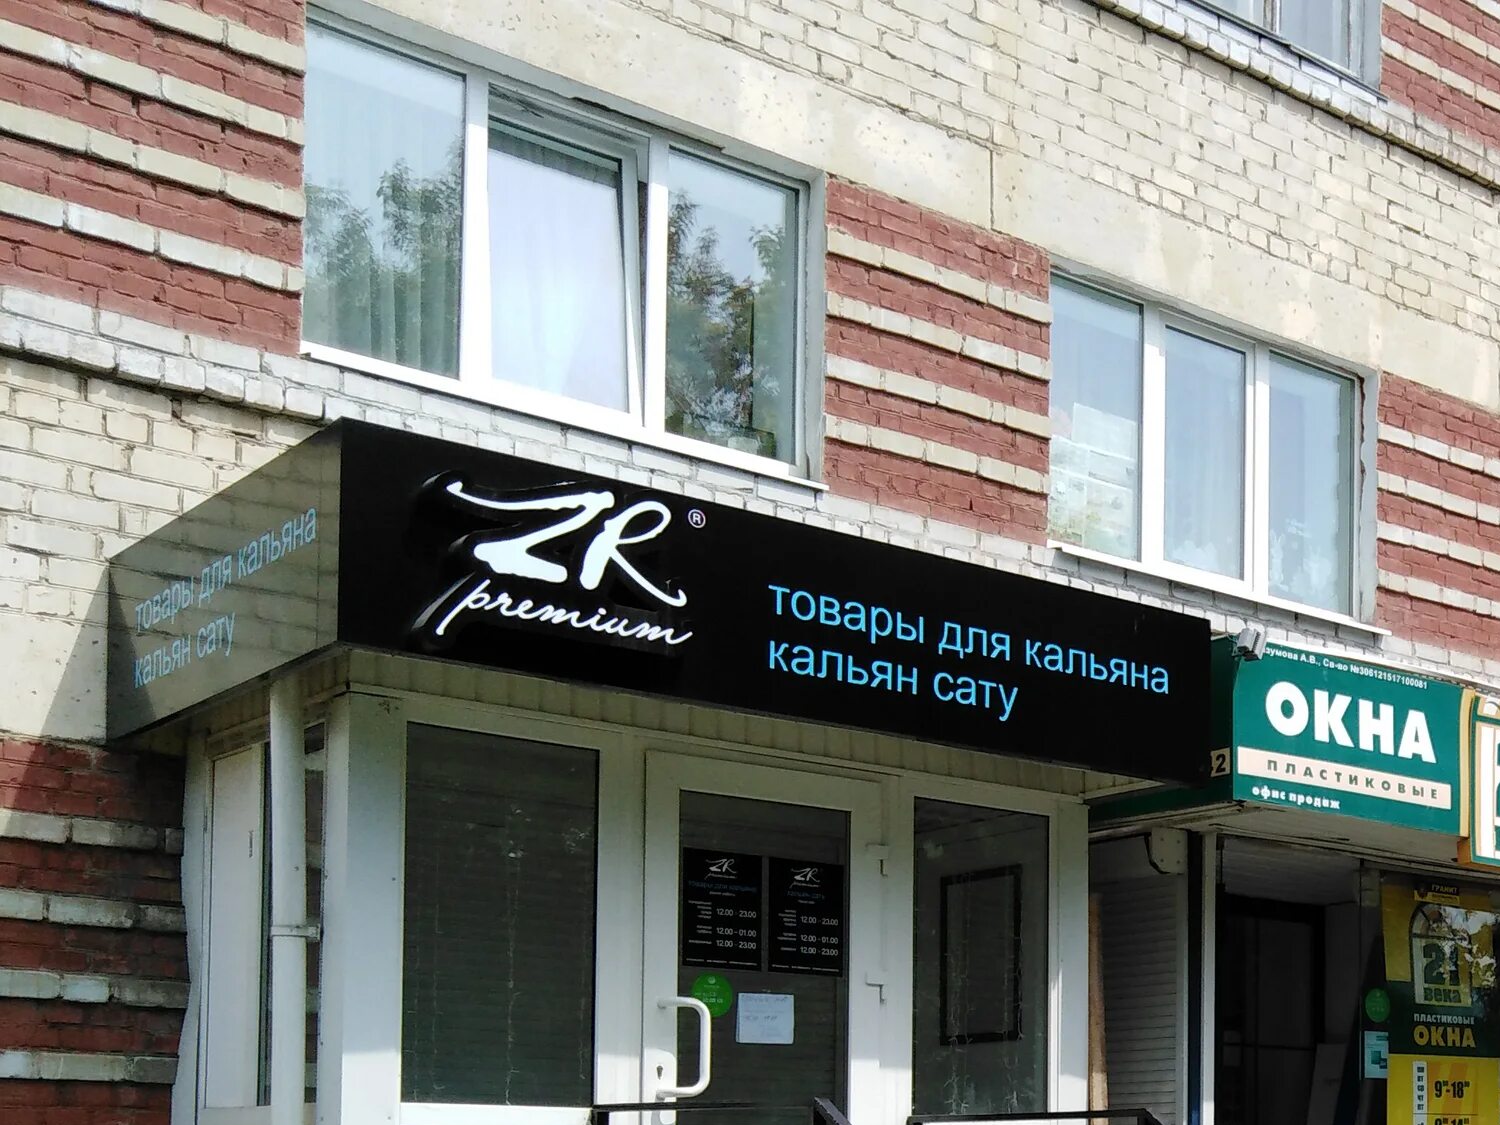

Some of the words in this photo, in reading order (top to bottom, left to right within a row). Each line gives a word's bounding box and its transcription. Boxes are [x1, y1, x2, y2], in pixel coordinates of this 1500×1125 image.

[135, 576, 194, 633] товары
[198, 554, 233, 607] для
[237, 507, 318, 579] кальяна
[446, 490, 688, 607] ZR
[436, 579, 693, 645] premium
[768, 584, 925, 644] товары
[938, 620, 1012, 661] для
[1025, 638, 1170, 695] кальяна
[135, 635, 192, 689] кальян
[196, 612, 236, 658] сату
[768, 640, 919, 695] кальян
[932, 670, 1019, 722] сату
[1264, 646, 1299, 661] зумова
[1265, 681, 1437, 764] ОКНА
[1252, 785, 1287, 801] офис
[1289, 791, 1340, 810] продаж
[1267, 759, 1439, 800] ПЛАСТИКОВЫЕ
[1413, 1013, 1475, 1026] ПЛАСТИКОВЫЕ
[1413, 1025, 1477, 1049] ОКНА
